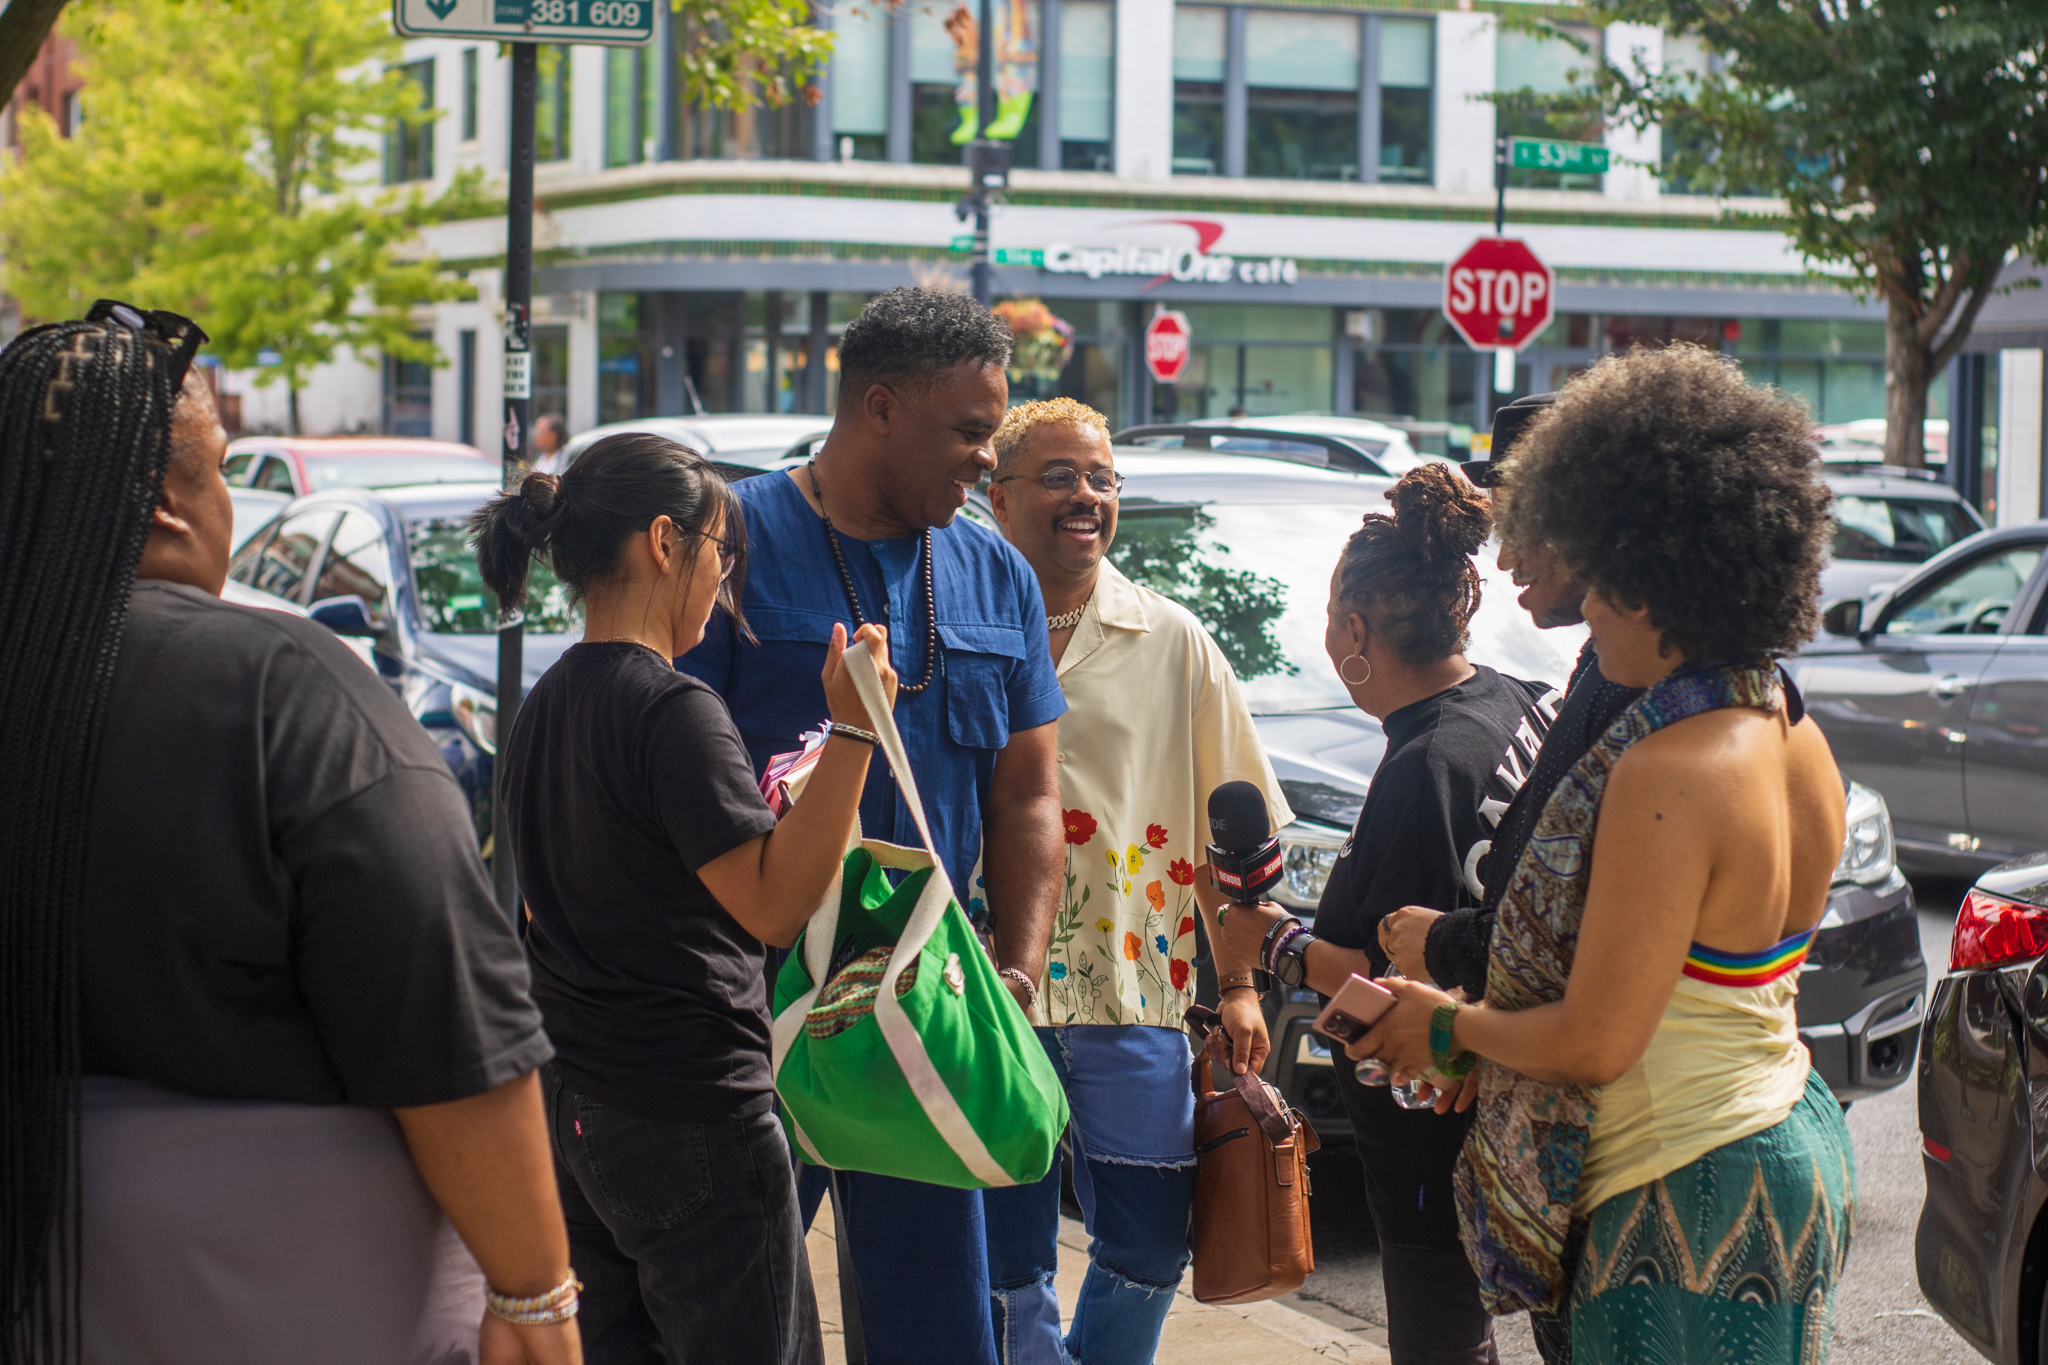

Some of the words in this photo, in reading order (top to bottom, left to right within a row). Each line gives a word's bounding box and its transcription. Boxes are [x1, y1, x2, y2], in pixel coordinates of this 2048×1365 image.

[532, 0, 579, 24] 381
[589, 2, 641, 26] 609
[1451, 268, 1547, 316] STOP
[1150, 332, 1185, 361] STOP
[506, 370, 525, 379] THE
